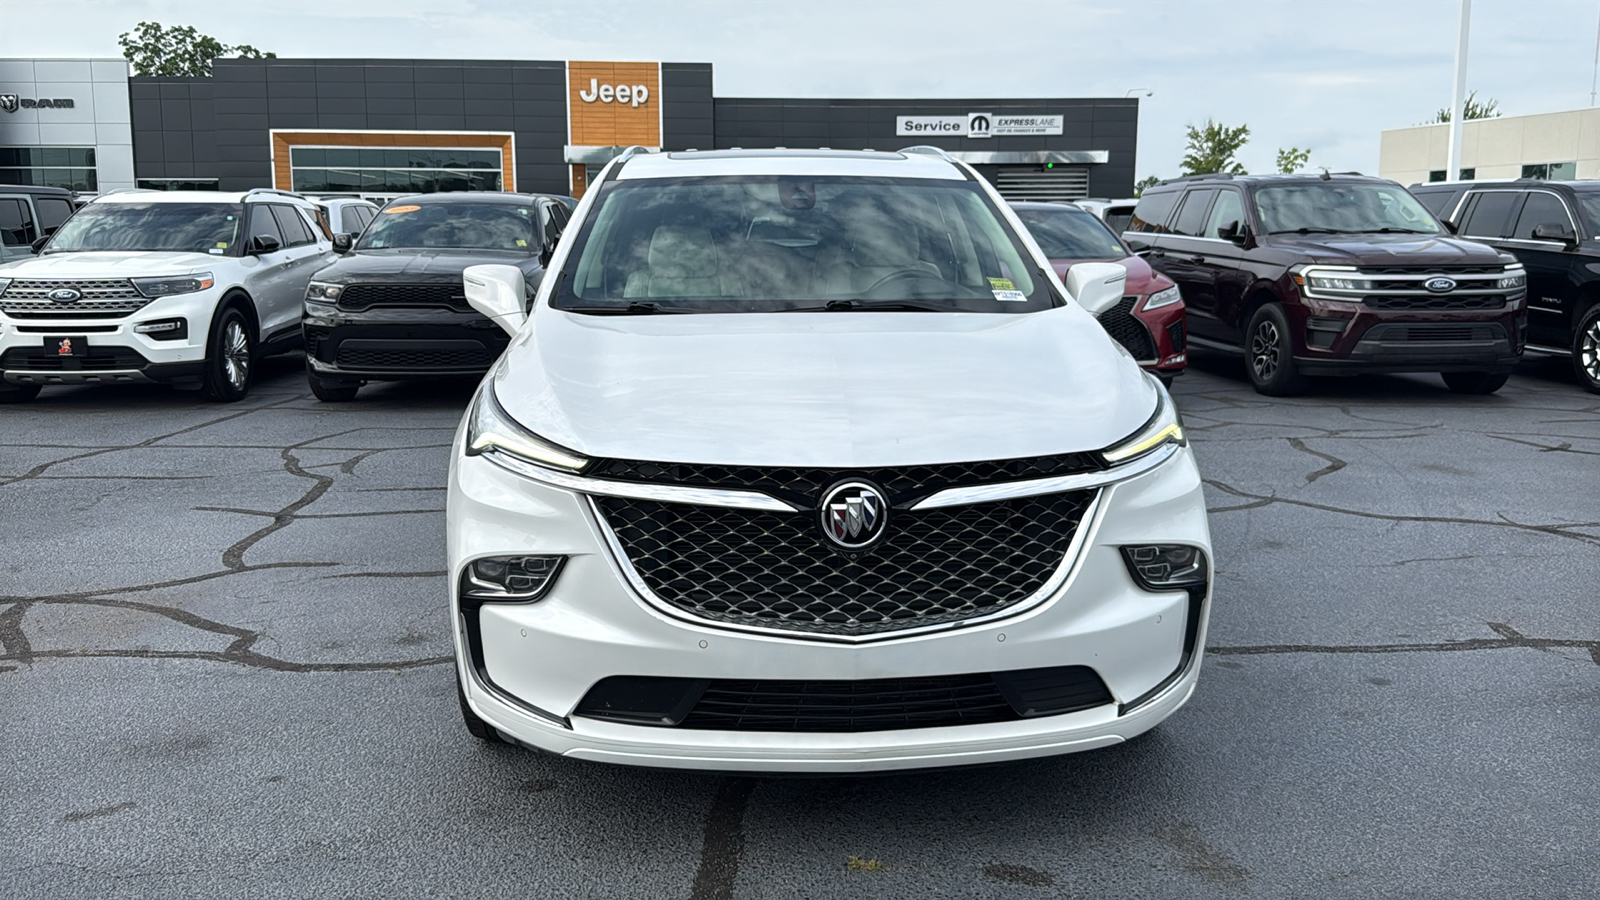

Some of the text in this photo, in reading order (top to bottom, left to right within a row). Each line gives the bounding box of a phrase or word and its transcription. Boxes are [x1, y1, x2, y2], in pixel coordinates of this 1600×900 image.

[579, 78, 649, 108] Jeep
[20, 98, 74, 109] RAM
[904, 120, 960, 131] Service
